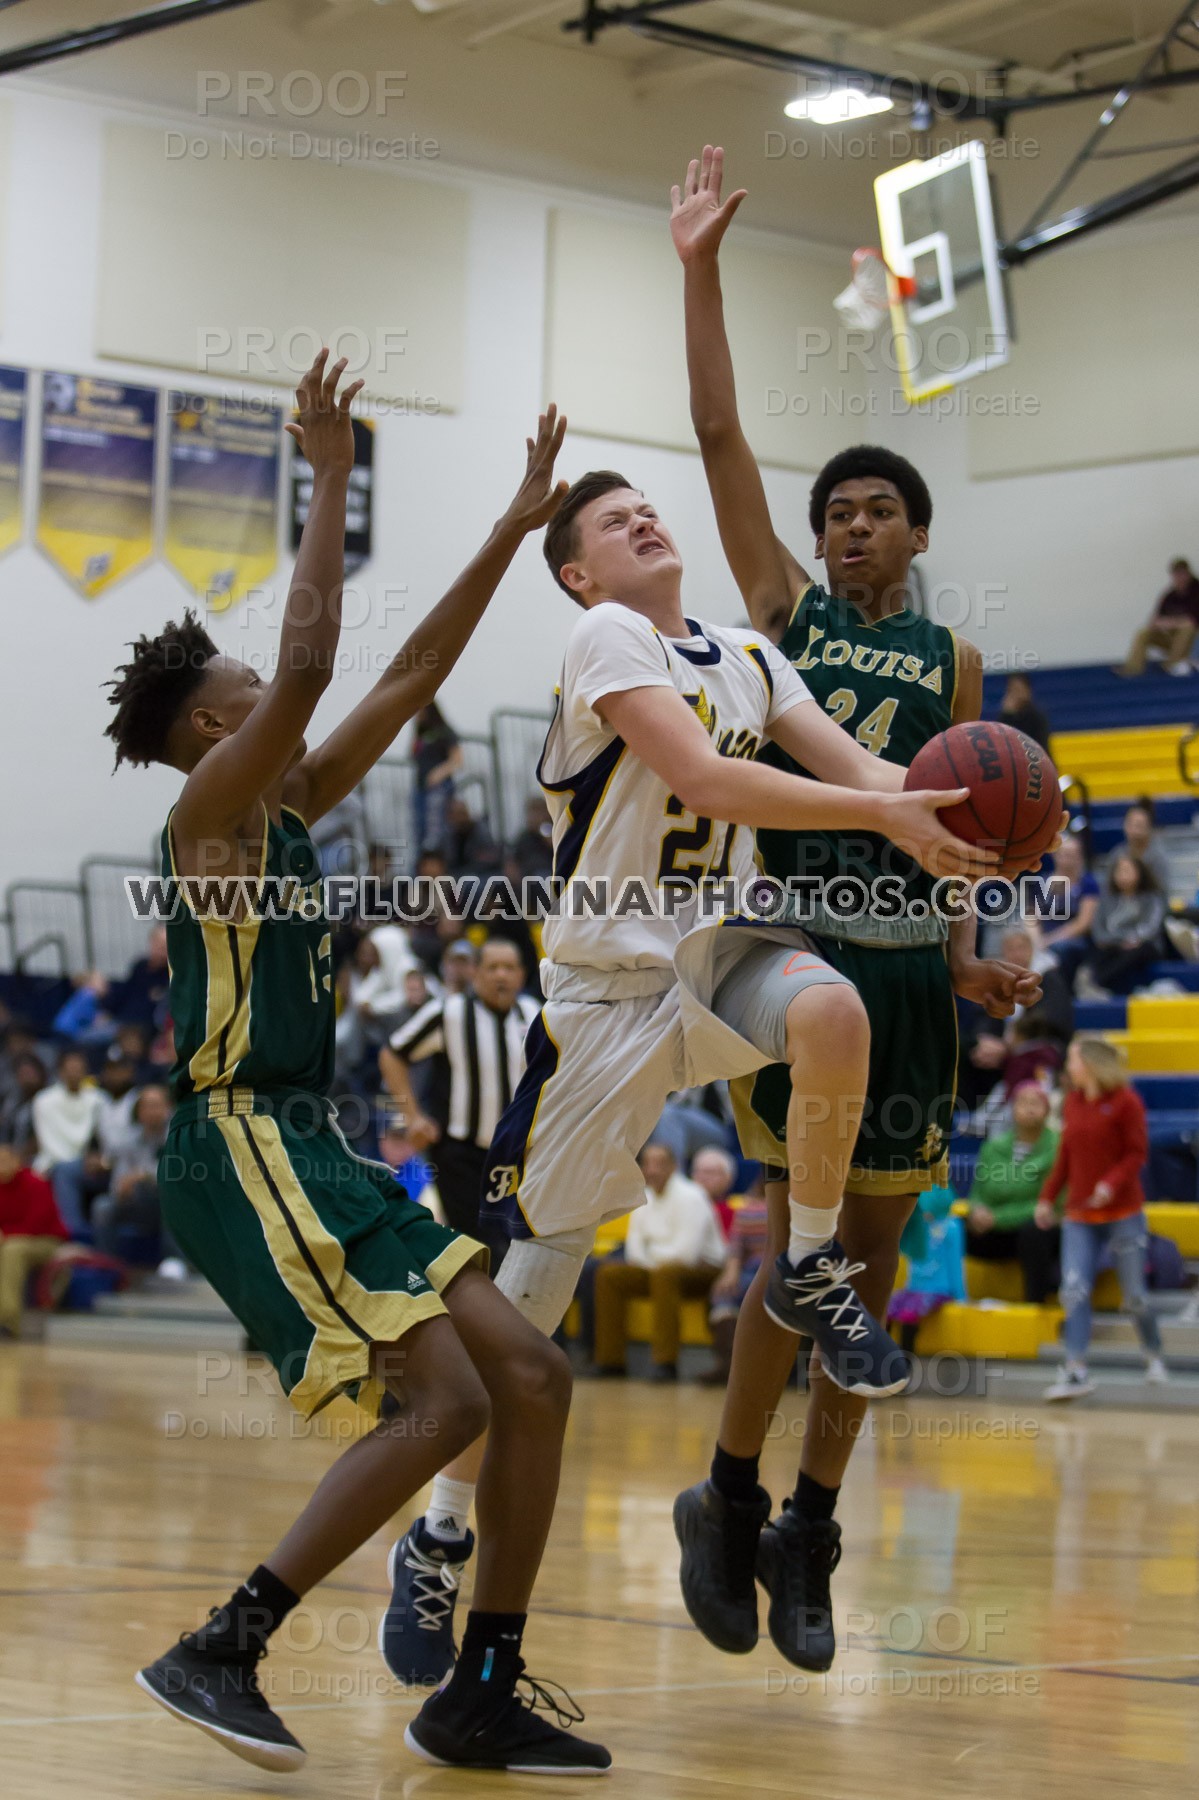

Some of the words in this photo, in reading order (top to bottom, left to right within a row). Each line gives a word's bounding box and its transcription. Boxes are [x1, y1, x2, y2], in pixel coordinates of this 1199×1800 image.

[790, 625, 942, 696] LOUISA
[825, 688, 899, 756] 24
[965, 725, 1004, 782] NCAA
